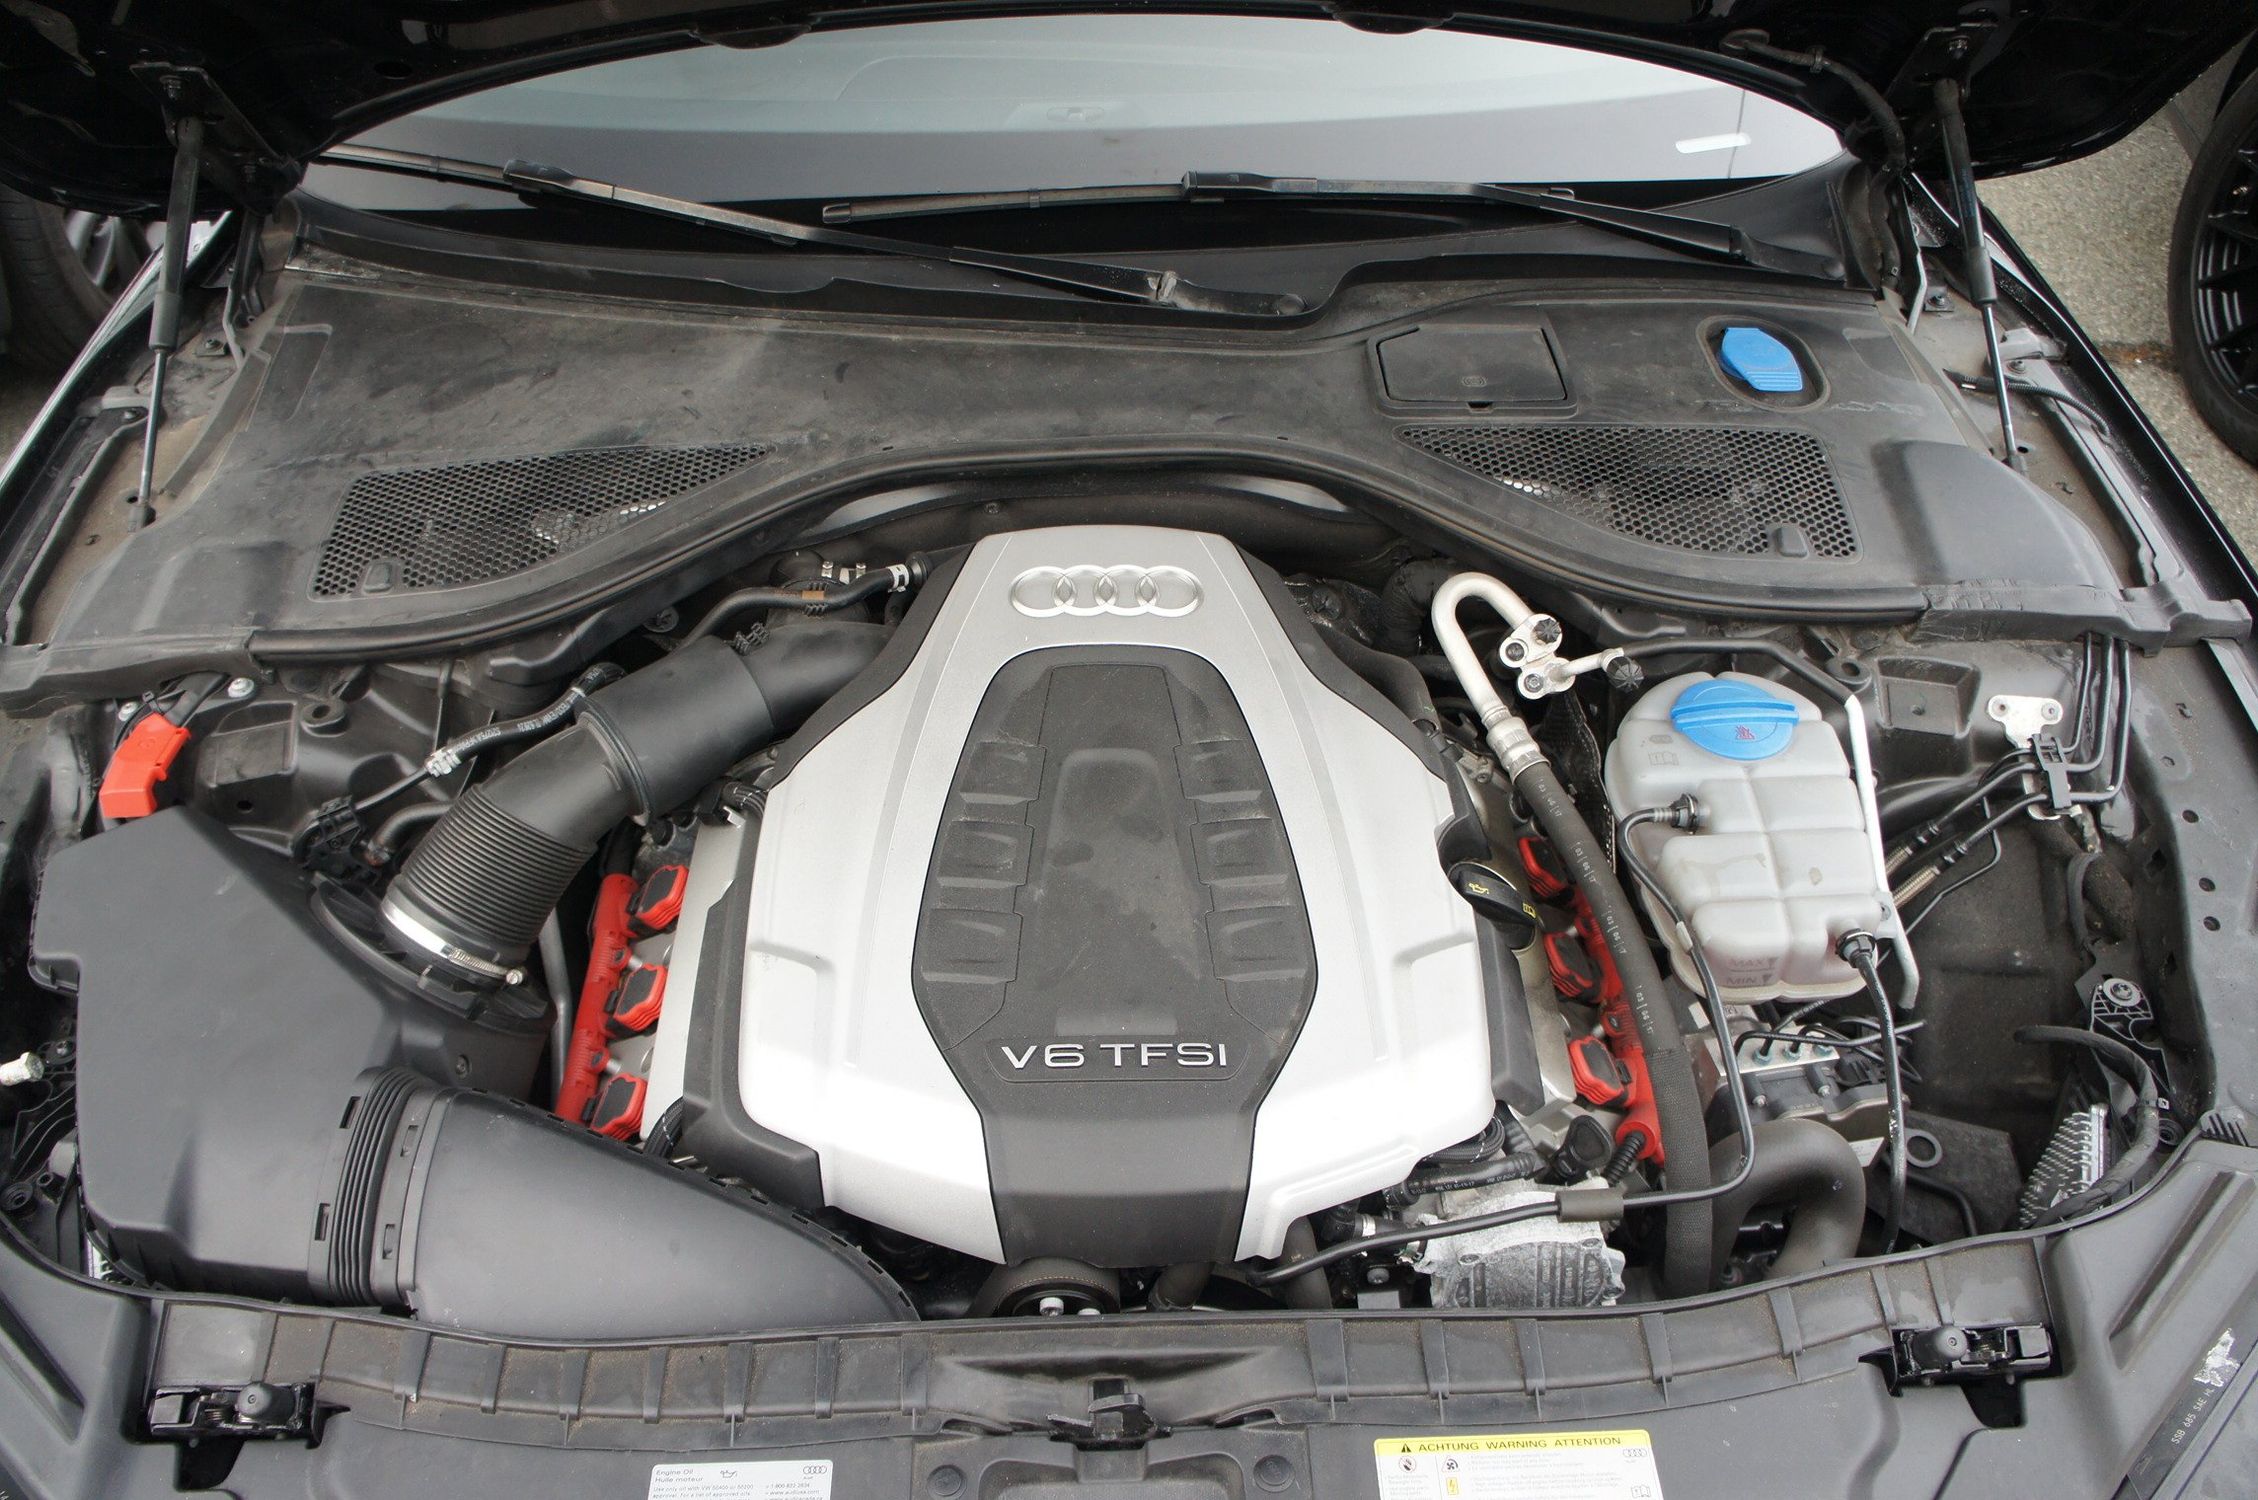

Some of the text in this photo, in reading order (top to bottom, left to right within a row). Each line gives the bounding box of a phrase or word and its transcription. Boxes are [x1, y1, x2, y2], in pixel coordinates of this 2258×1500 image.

[1000, 1042, 1228, 1069] V6 TFSI
[1418, 1436, 1622, 1452] ACHTUNG WARNING ATTENTION
